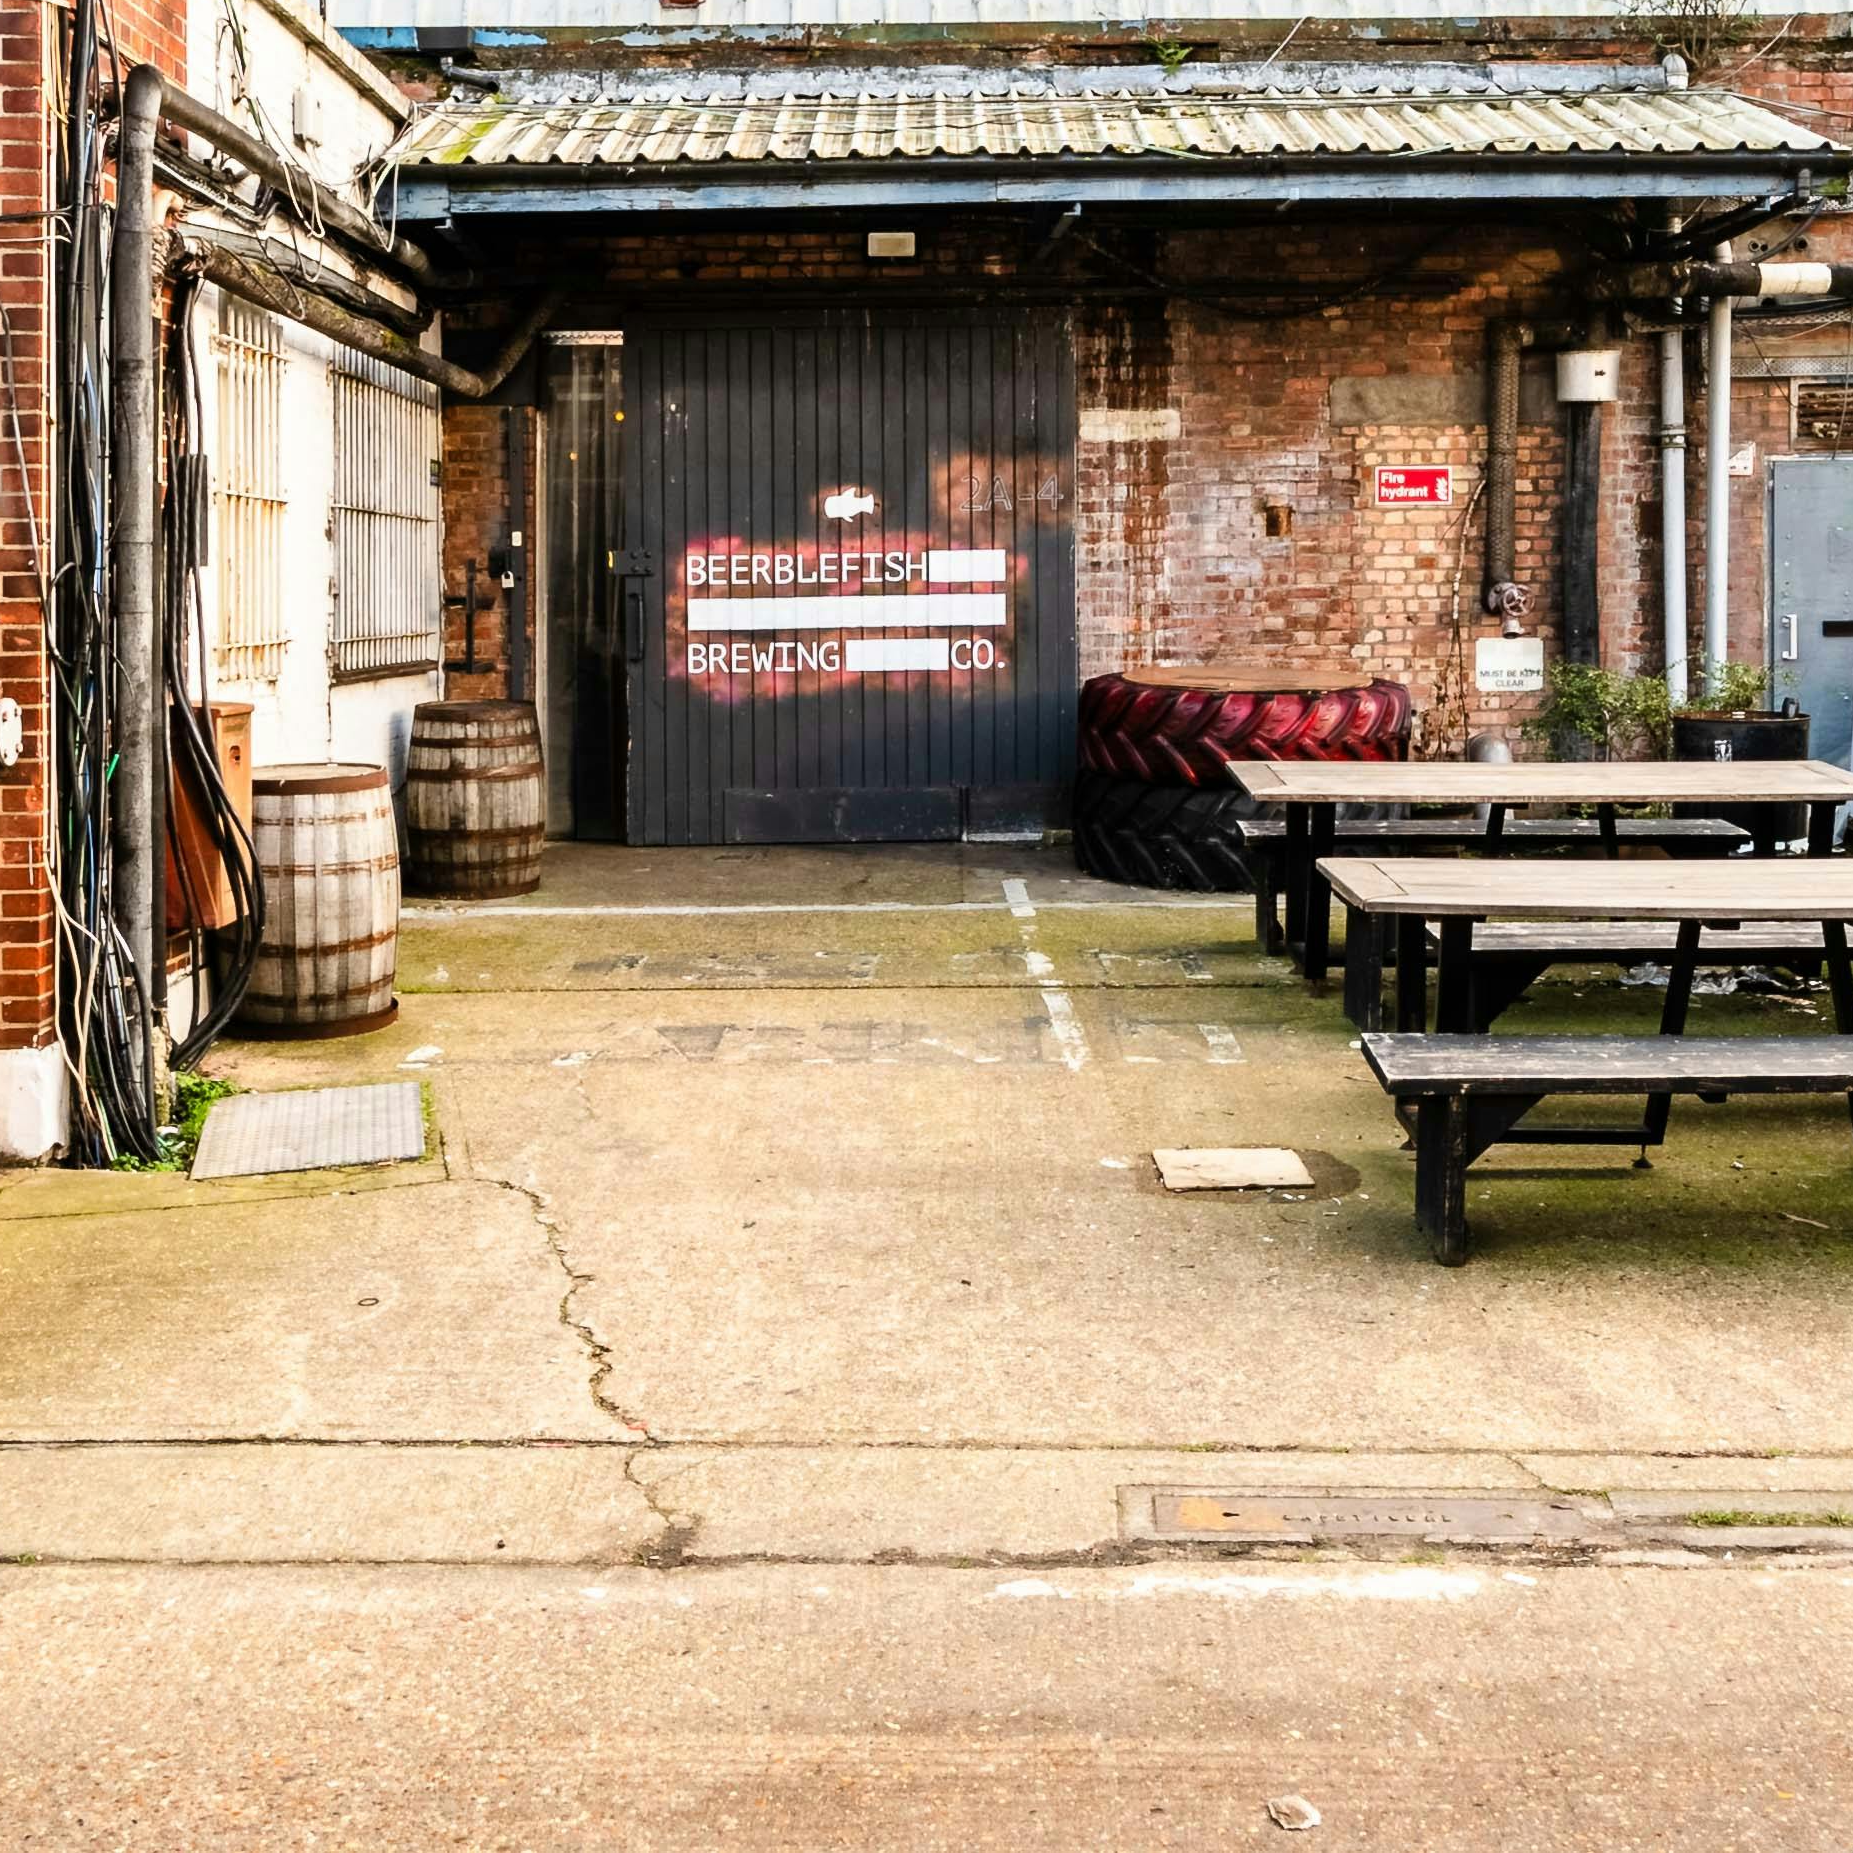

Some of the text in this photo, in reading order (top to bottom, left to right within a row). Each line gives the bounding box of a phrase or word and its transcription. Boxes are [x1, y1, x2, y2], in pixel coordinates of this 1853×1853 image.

[1380, 472, 1406, 484] Fire
[959, 474, 1065, 511] 2A-4
[1380, 485, 1429, 500] hydrant
[686, 551, 927, 586] BEERBLEFISH
[687, 638, 1006, 674] BREWING CO.
[1479, 669, 1504, 677] MUST
[1506, 669, 1517, 677] BE
[1495, 679, 1524, 687] CLEAR
